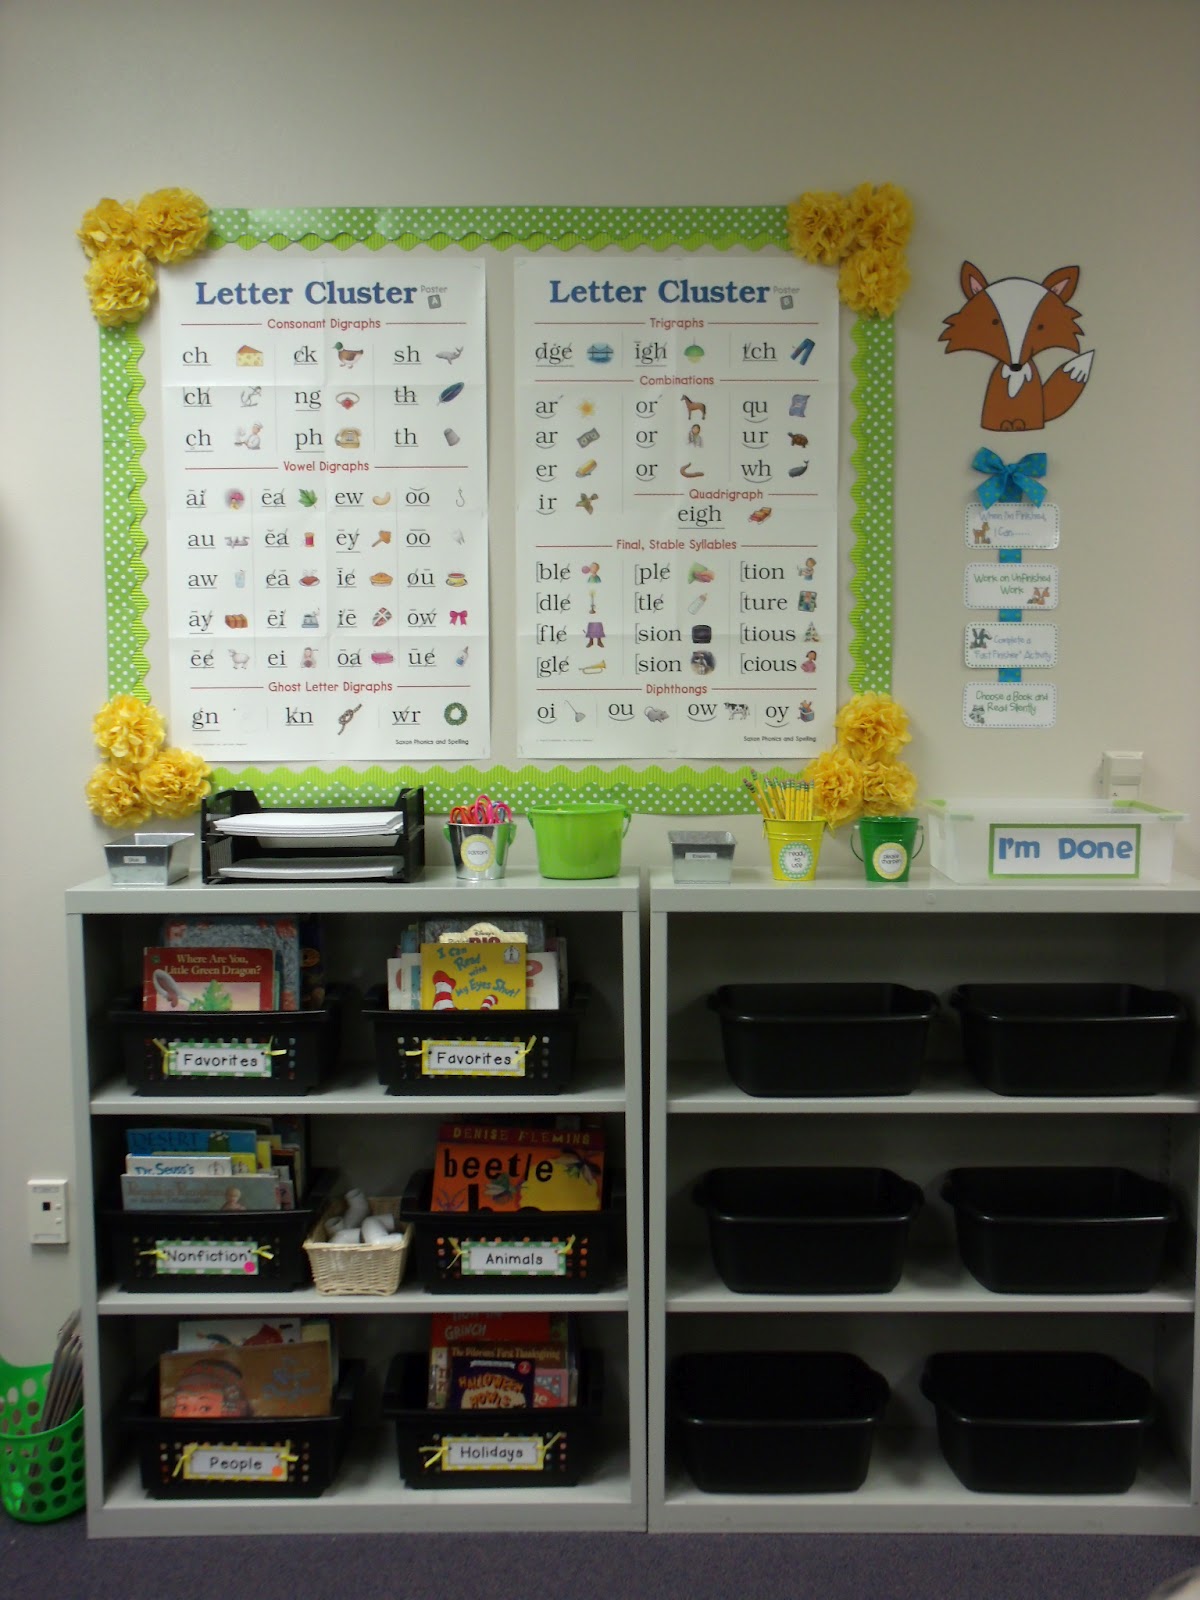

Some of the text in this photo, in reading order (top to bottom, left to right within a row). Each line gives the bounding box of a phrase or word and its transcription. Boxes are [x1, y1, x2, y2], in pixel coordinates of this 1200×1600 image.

[195, 280, 418, 305] Letter Cluster
[420, 285, 448, 294] Poster
[549, 279, 770, 303] Letter Cluster
[772, 285, 799, 294] Poster
[267, 318, 381, 331] Consonant Digraphs
[649, 318, 704, 330] Trigraphs
[182, 347, 209, 364] ch
[293, 345, 318, 363] ck
[394, 346, 420, 363] sh
[639, 375, 714, 386] Combinations
[184, 387, 211, 405] ch
[294, 390, 321, 409] ng
[742, 400, 768, 417] qu
[185, 429, 212, 447] ch
[295, 428, 323, 449] ph
[394, 428, 418, 445] th
[536, 430, 558, 444] ar
[635, 430, 658, 444] or
[742, 431, 768, 444] ur
[283, 461, 369, 473] Vowel Digraphs
[536, 463, 557, 477] er
[635, 463, 658, 477] or
[741, 458, 772, 477] wh
[335, 492, 364, 506] ew
[689, 489, 763, 501] Quadrigraph
[538, 495, 557, 510] ir
[677, 505, 722, 527] eigh
[187, 534, 215, 547] au
[616, 540, 737, 551] Final, Stable Syllables
[188, 574, 218, 587] aw
[973, 573, 998, 583] Work
[1000, 585, 1024, 595] Work
[267, 650, 287, 666] ei
[268, 682, 393, 693] Ghost Letter Digraphs
[646, 684, 708, 696] Diphthongs
[976, 690, 1004, 701] Choose
[1012, 691, 1033, 702] Book
[1035, 693, 1048, 701] and
[537, 702, 557, 718] oi
[608, 703, 634, 716] ou
[688, 703, 717, 716] ow
[765, 705, 789, 723] oy
[987, 702, 1008, 712] Read
[192, 707, 219, 729] gn
[285, 706, 314, 723] kn
[392, 706, 421, 724] wr
[795, 735, 816, 743] Spelling
[998, 837, 1134, 860] I'm Done
[176, 954, 249, 964] Where Are You,
[436, 947, 446, 960] I
[453, 954, 481, 972] Read
[164, 965, 262, 978] Little Green Dragon?
[469, 978, 492, 992] Eyes
[492, 978, 521, 998] Shut!
[184, 1053, 258, 1067] Favorites
[437, 1051, 512, 1065] Favorites
[130, 1132, 200, 1148] DESERT
[453, 1127, 591, 1145] DENISE FLEMING
[444, 1147, 554, 1182] beetle
[166, 1249, 249, 1263] Nonfiction
[485, 1253, 543, 1266] Animals
[444, 1323, 487, 1341] GRINCH
[460, 1446, 524, 1462] Holidays
[209, 1456, 263, 1473] People
